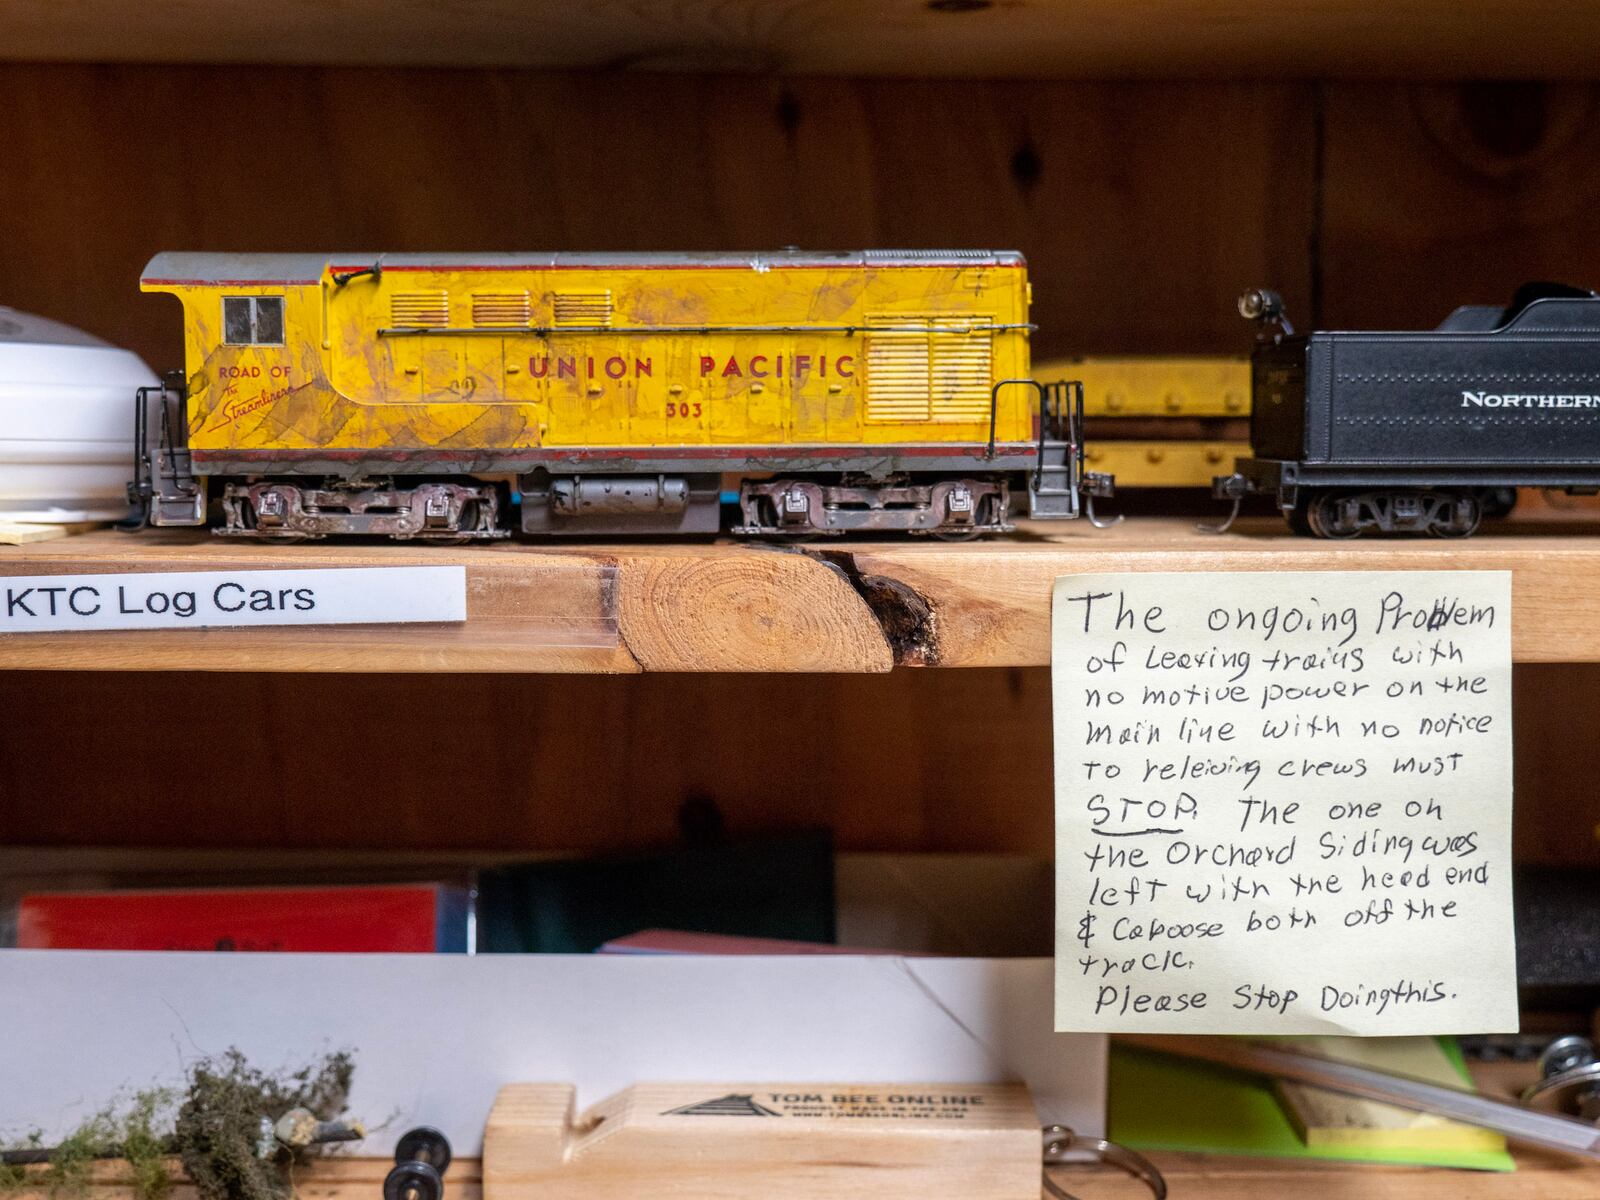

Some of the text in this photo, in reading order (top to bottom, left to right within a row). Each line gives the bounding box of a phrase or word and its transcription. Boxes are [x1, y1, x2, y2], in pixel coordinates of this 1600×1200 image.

[219, 366, 291, 378] ROAD OF
[529, 355, 854, 378] UNION PACIFIC
[666, 402, 702, 418] 303
[7, 582, 316, 617] KTC Log Cars
[1067, 591, 1166, 633] The
[1208, 597, 1357, 647] ongoing
[1087, 641, 1127, 673] of
[1262, 647, 1364, 672] trains
[1392, 639, 1463, 666] with
[1085, 676, 1487, 709] no motive power on the
[1179, 717, 1235, 743] line
[1262, 714, 1340, 738] with
[1361, 721, 1400, 738] no
[1419, 713, 1492, 737] notice
[1278, 759, 1367, 777] crews
[1238, 796, 1299, 832] The
[1329, 802, 1382, 820] one
[1405, 798, 1442, 820] on
[1084, 828, 1478, 872] the Orchard Siding was
[1089, 861, 1489, 906] left with the head end
[1077, 898, 1456, 948] & Caboose both off the
[1095, 985, 1206, 1016] Please
[1233, 984, 1298, 1014] Stop
[769, 1093, 985, 1105] TOM BEE ONLINE
